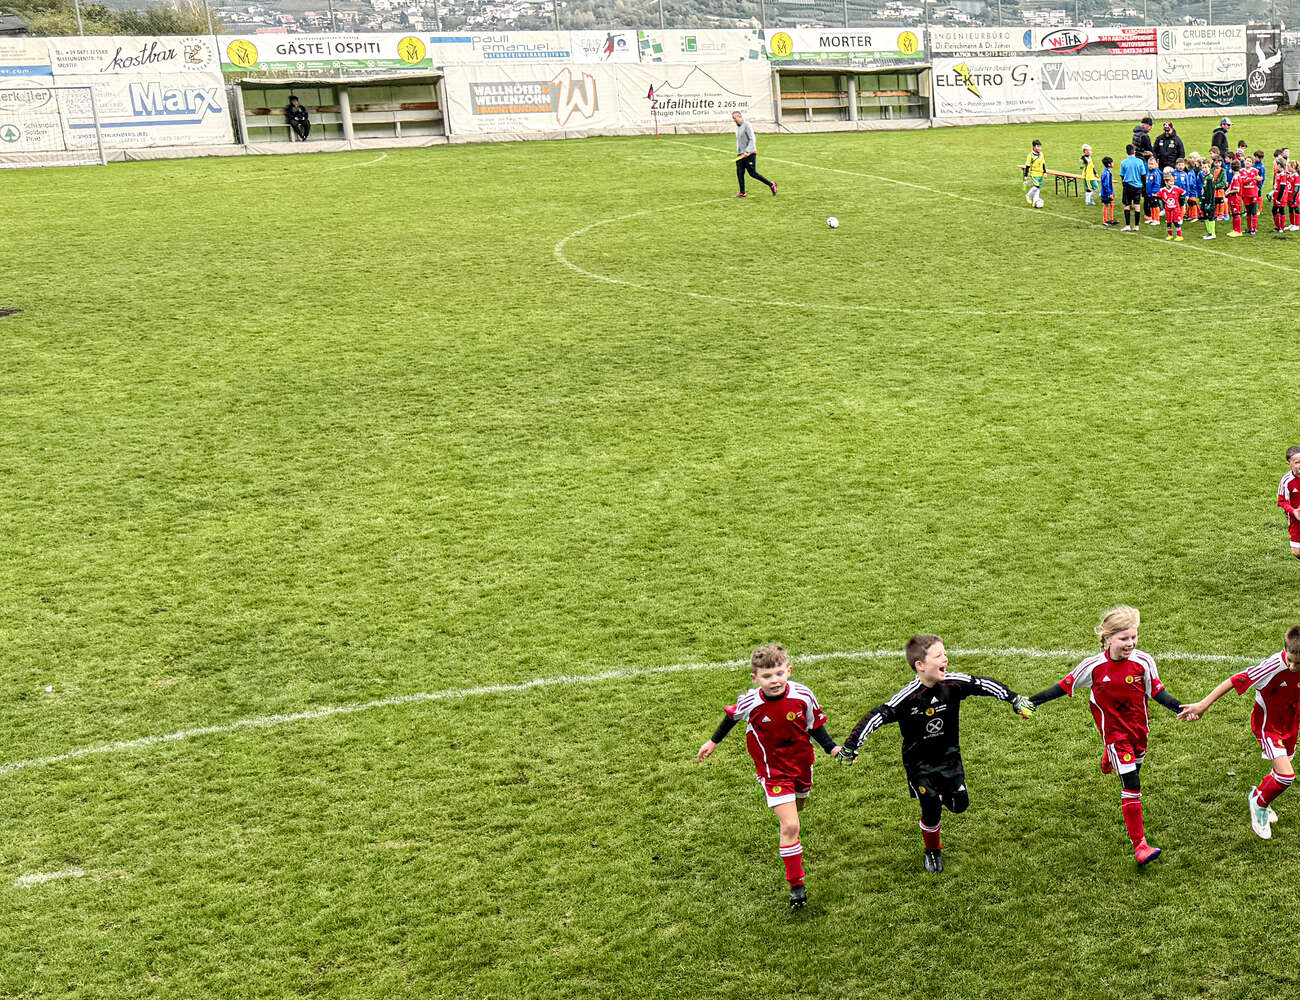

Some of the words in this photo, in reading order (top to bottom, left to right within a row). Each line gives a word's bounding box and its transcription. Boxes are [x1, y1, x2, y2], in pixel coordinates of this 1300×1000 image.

[934, 31, 1010, 40] INGENIEURBÜRO
[1218, 29, 1242, 38] HOLZ
[482, 43, 549, 52] emanuel
[819, 36, 872, 47] MORTER
[276, 41, 324, 55] GÄSTE
[335, 42, 380, 53] OSPITI
[100, 42, 178, 72] kostbar
[936, 74, 1003, 87] ELEKTRO
[1066, 69, 1129, 81] VINSCHGER
[1131, 69, 1153, 80] BAU
[474, 82, 541, 96] WALLNÖFER
[129, 82, 222, 117] Marx
[475, 94, 551, 106] WELLENZOHN
[651, 98, 715, 110] Zufallhütte
